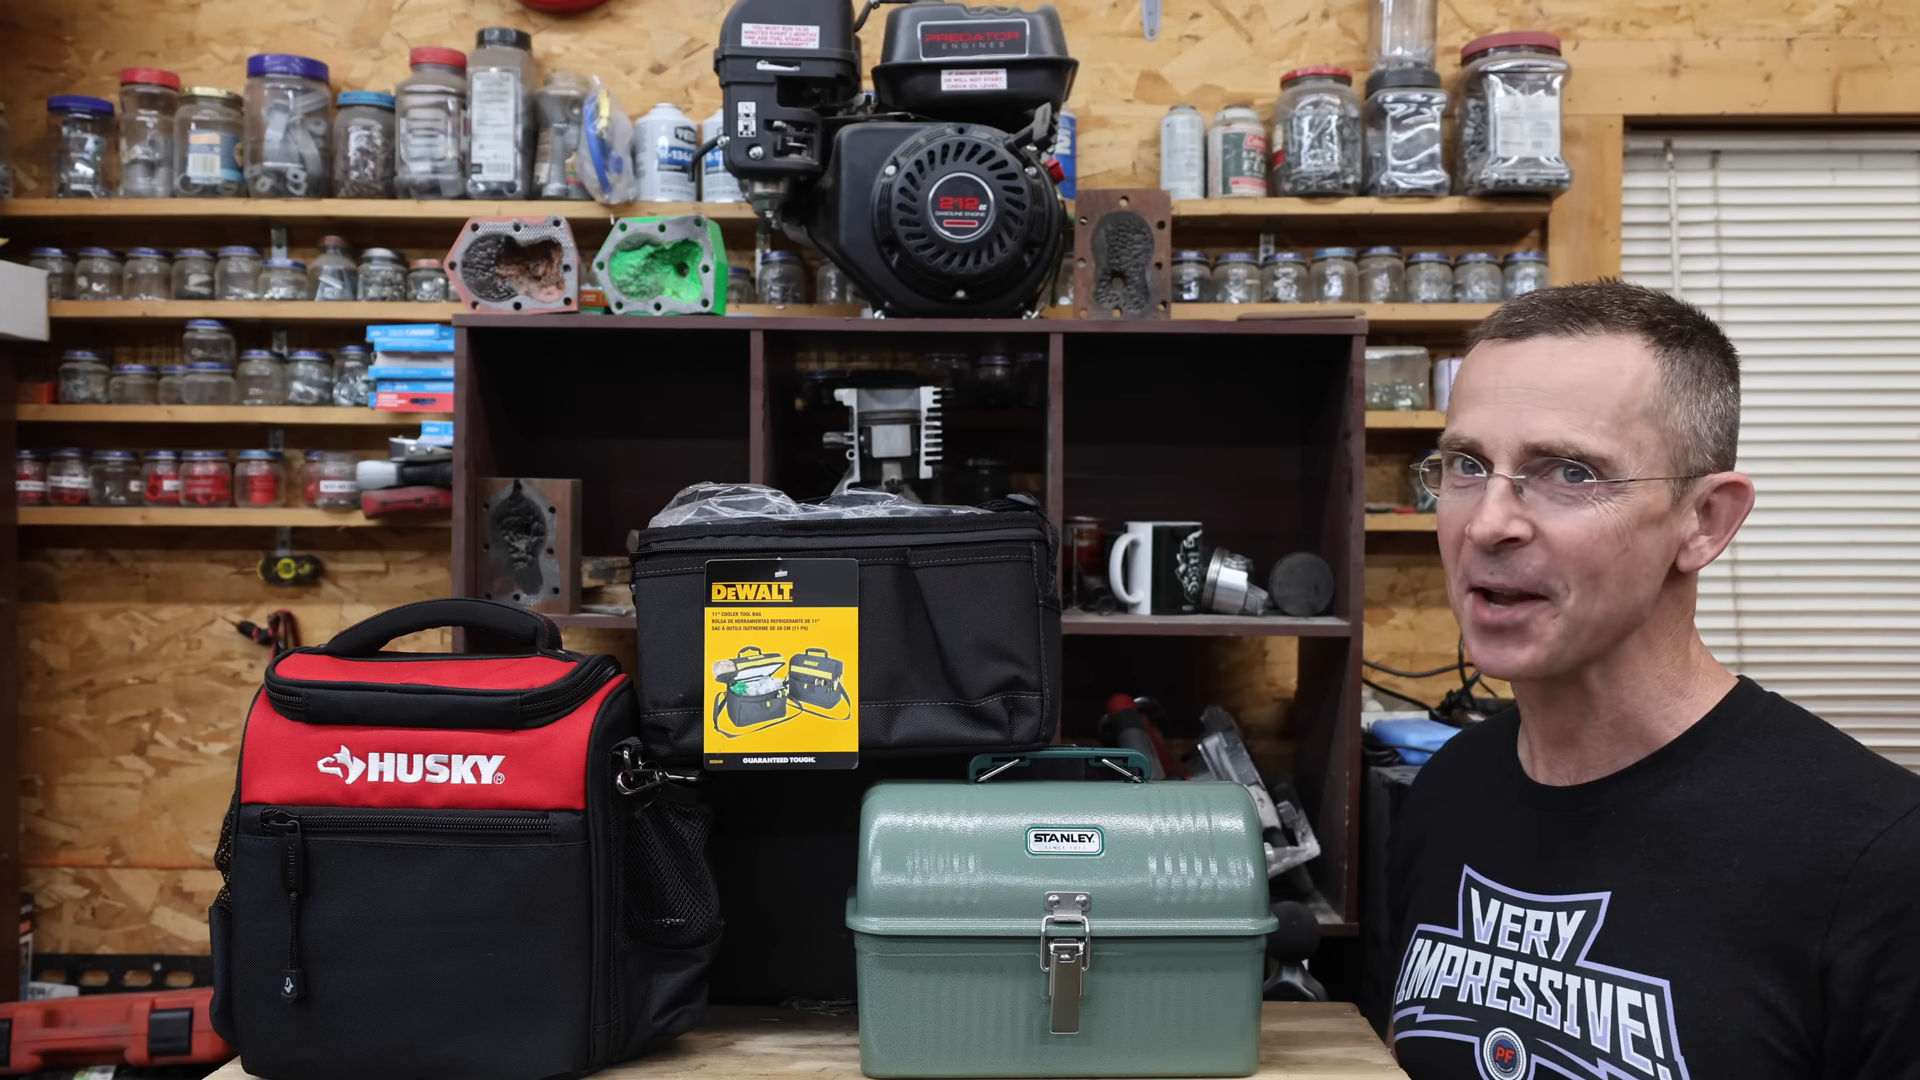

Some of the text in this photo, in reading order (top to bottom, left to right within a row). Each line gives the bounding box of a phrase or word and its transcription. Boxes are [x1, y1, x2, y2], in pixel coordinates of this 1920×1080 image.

[925, 32, 1020, 43] PREDATOR
[941, 42, 1005, 50] ENGINES
[1034, 833, 1094, 843] STANLEY
[1471, 887, 1587, 962] VERY
[1395, 938, 1673, 1080] IMPRESSIVE!
[1495, 1045, 1516, 1064] PF
